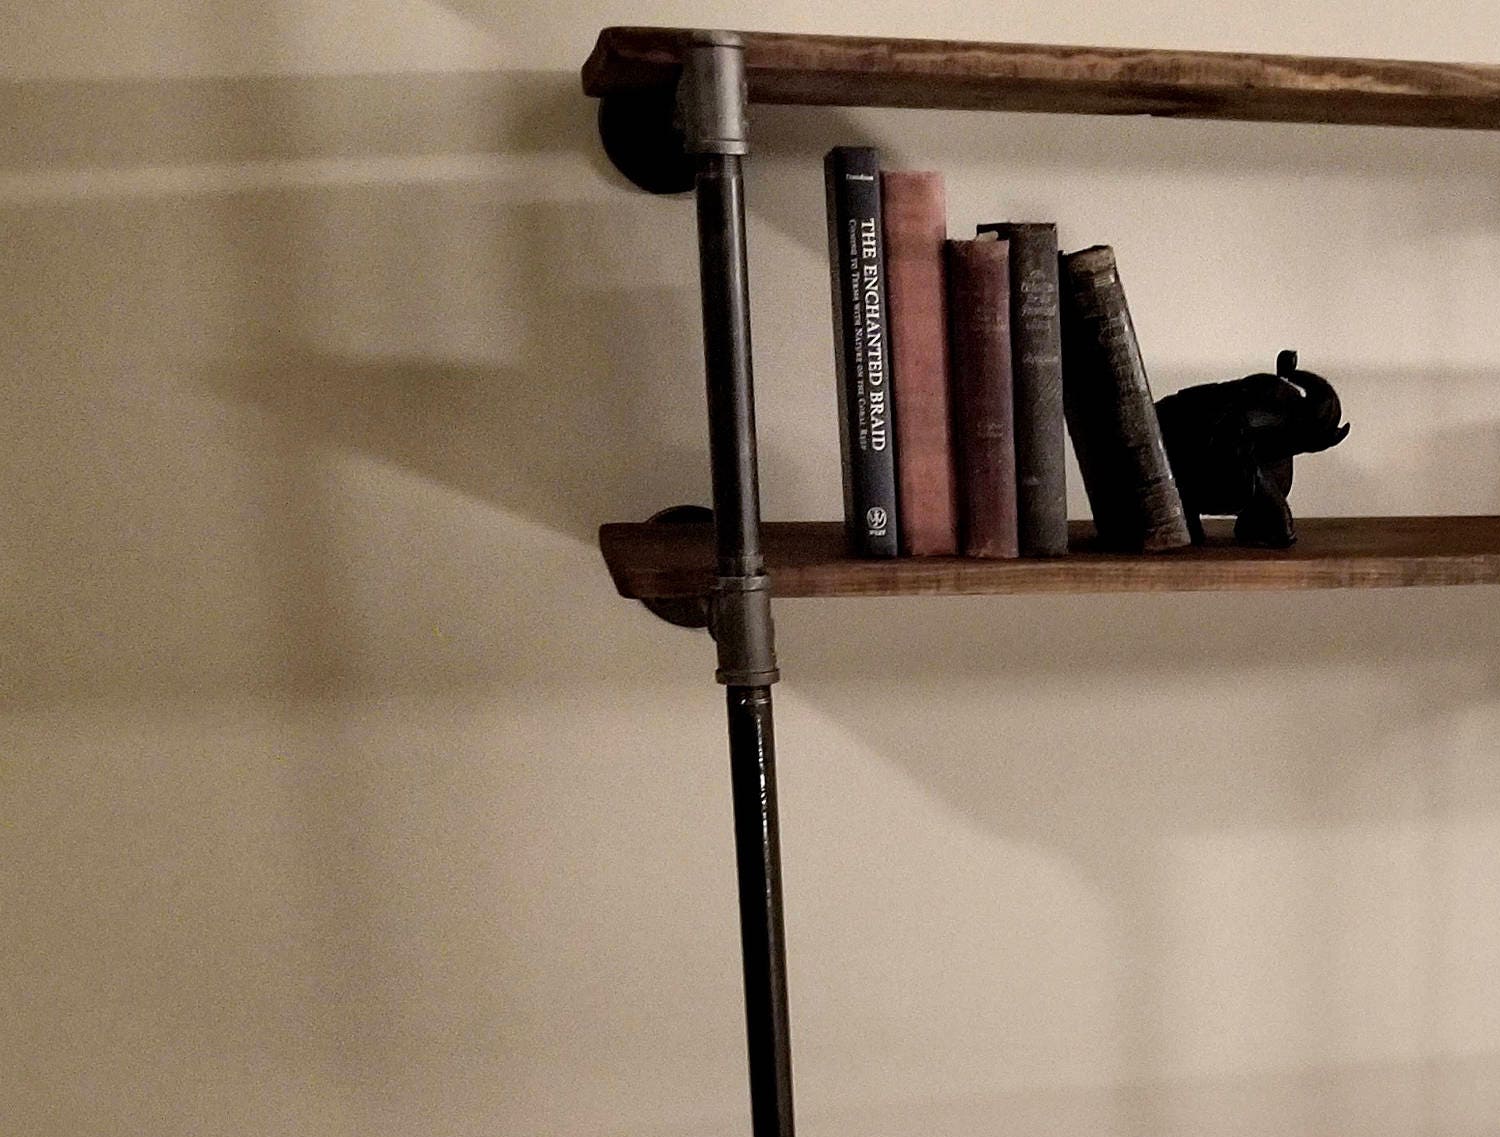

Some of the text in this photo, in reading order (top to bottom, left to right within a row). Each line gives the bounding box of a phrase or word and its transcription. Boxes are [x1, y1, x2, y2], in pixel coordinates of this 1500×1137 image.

[861, 218, 886, 451] THE ENCHANTED BRAID
